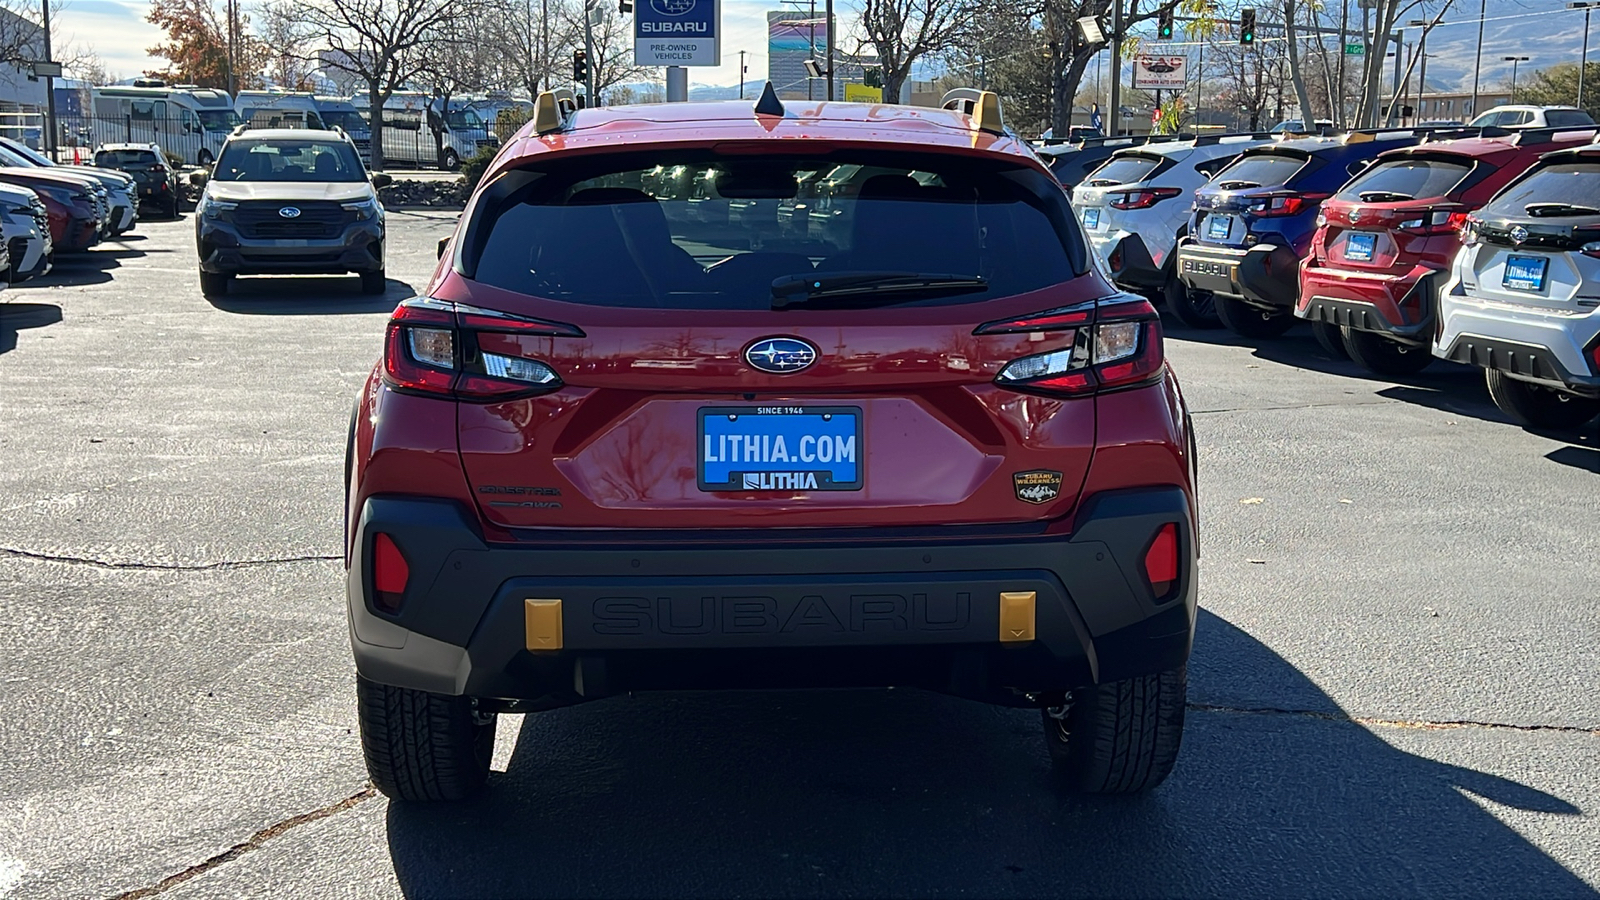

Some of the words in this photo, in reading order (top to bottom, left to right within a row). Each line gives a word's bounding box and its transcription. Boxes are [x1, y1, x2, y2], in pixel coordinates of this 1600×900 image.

[641, 21, 707, 33] SUBARU
[650, 44, 698, 52] PRE-OWNED
[655, 52, 693, 60] VEHICLES
[1185, 260, 1228, 278] SUBARU
[757, 407, 782, 415] SINCE
[784, 407, 804, 415] 1946
[704, 434, 855, 463] LITHIA.COM
[760, 473, 818, 489] LITHIA
[478, 486, 562, 497] CROSSTREK
[520, 501, 562, 509] AWD
[591, 591, 971, 635] SUBARU
